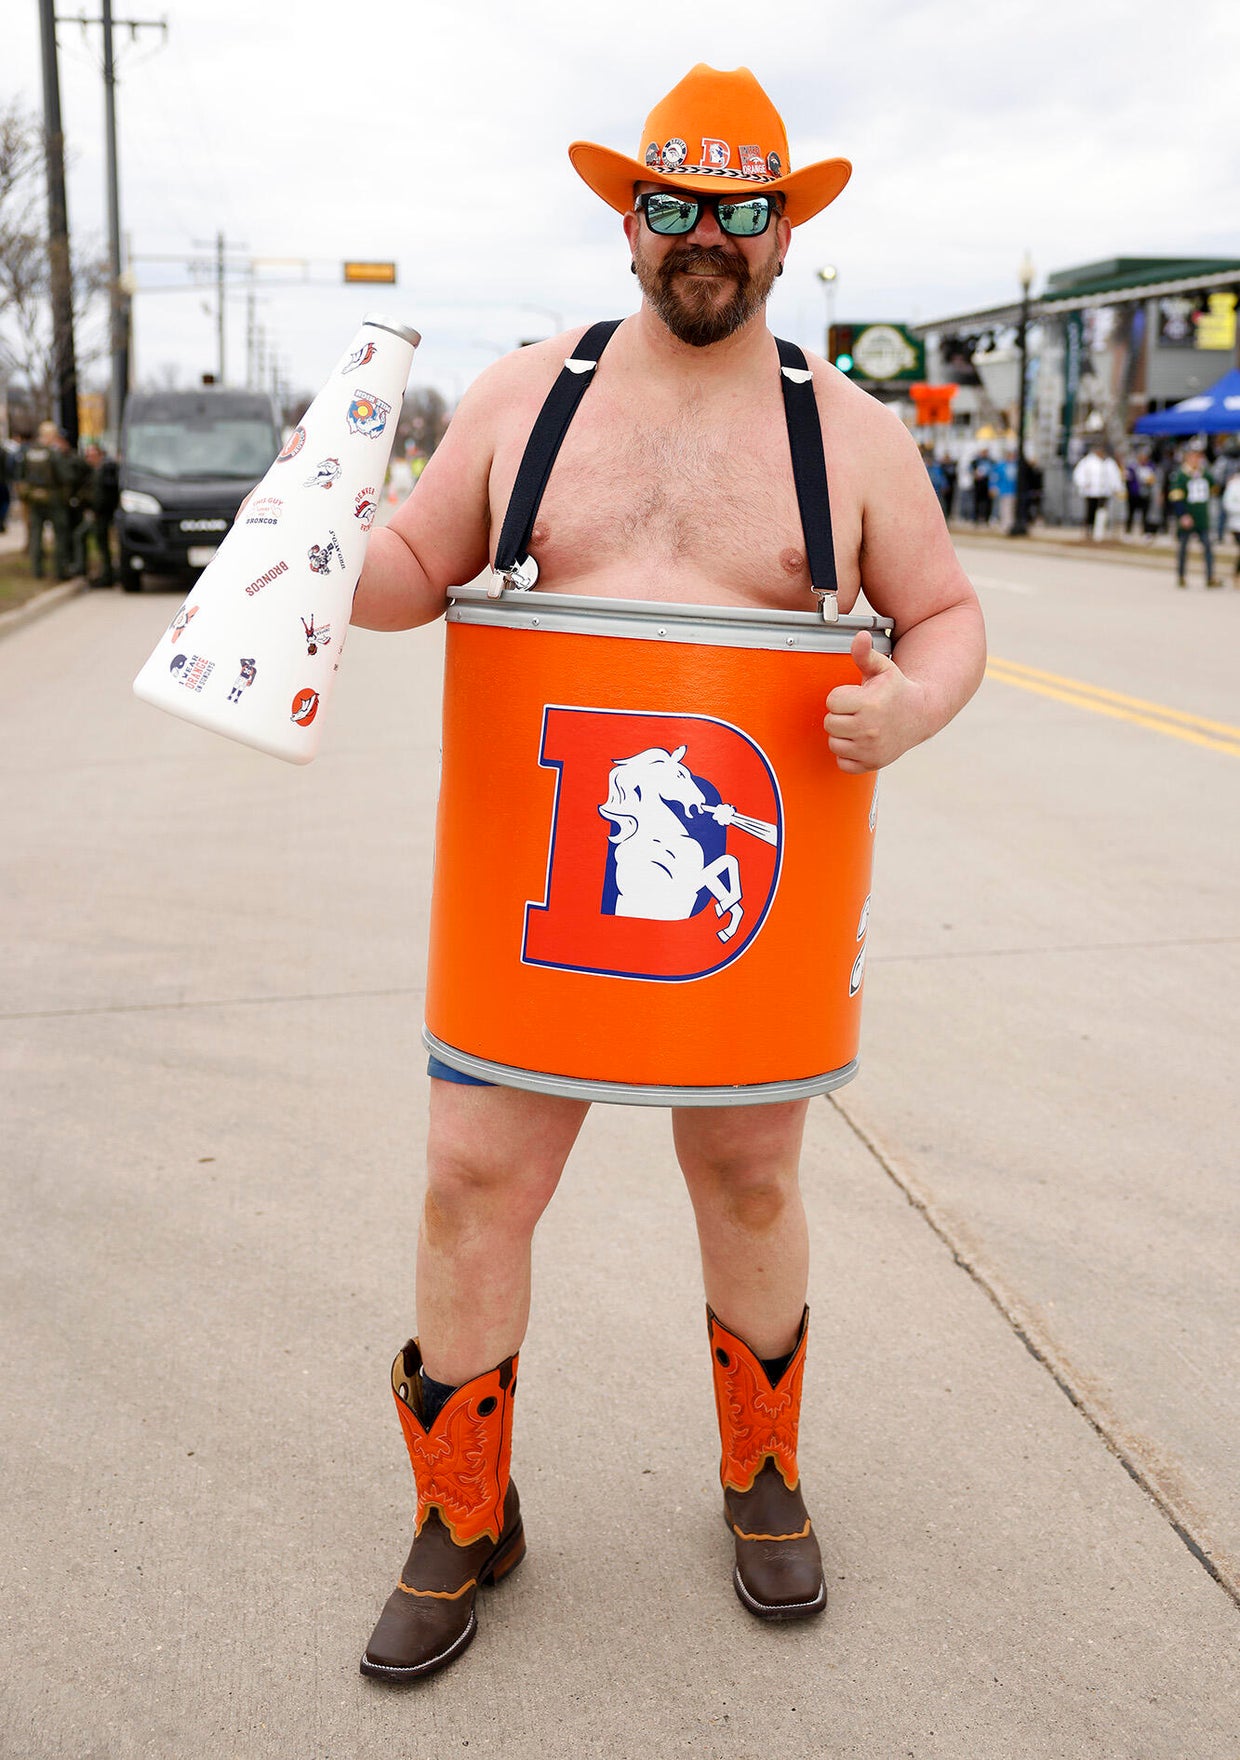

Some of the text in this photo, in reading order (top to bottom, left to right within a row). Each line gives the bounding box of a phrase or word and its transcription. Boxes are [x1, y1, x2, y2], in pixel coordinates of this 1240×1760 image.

[267, 497, 283, 506] GUY
[246, 517, 278, 525] BRONCOS
[245, 561, 289, 597] BRONCOS
[182, 654, 199, 679] WEAR
[184, 657, 209, 690] ORANGE
[520, 703, 785, 983] D
